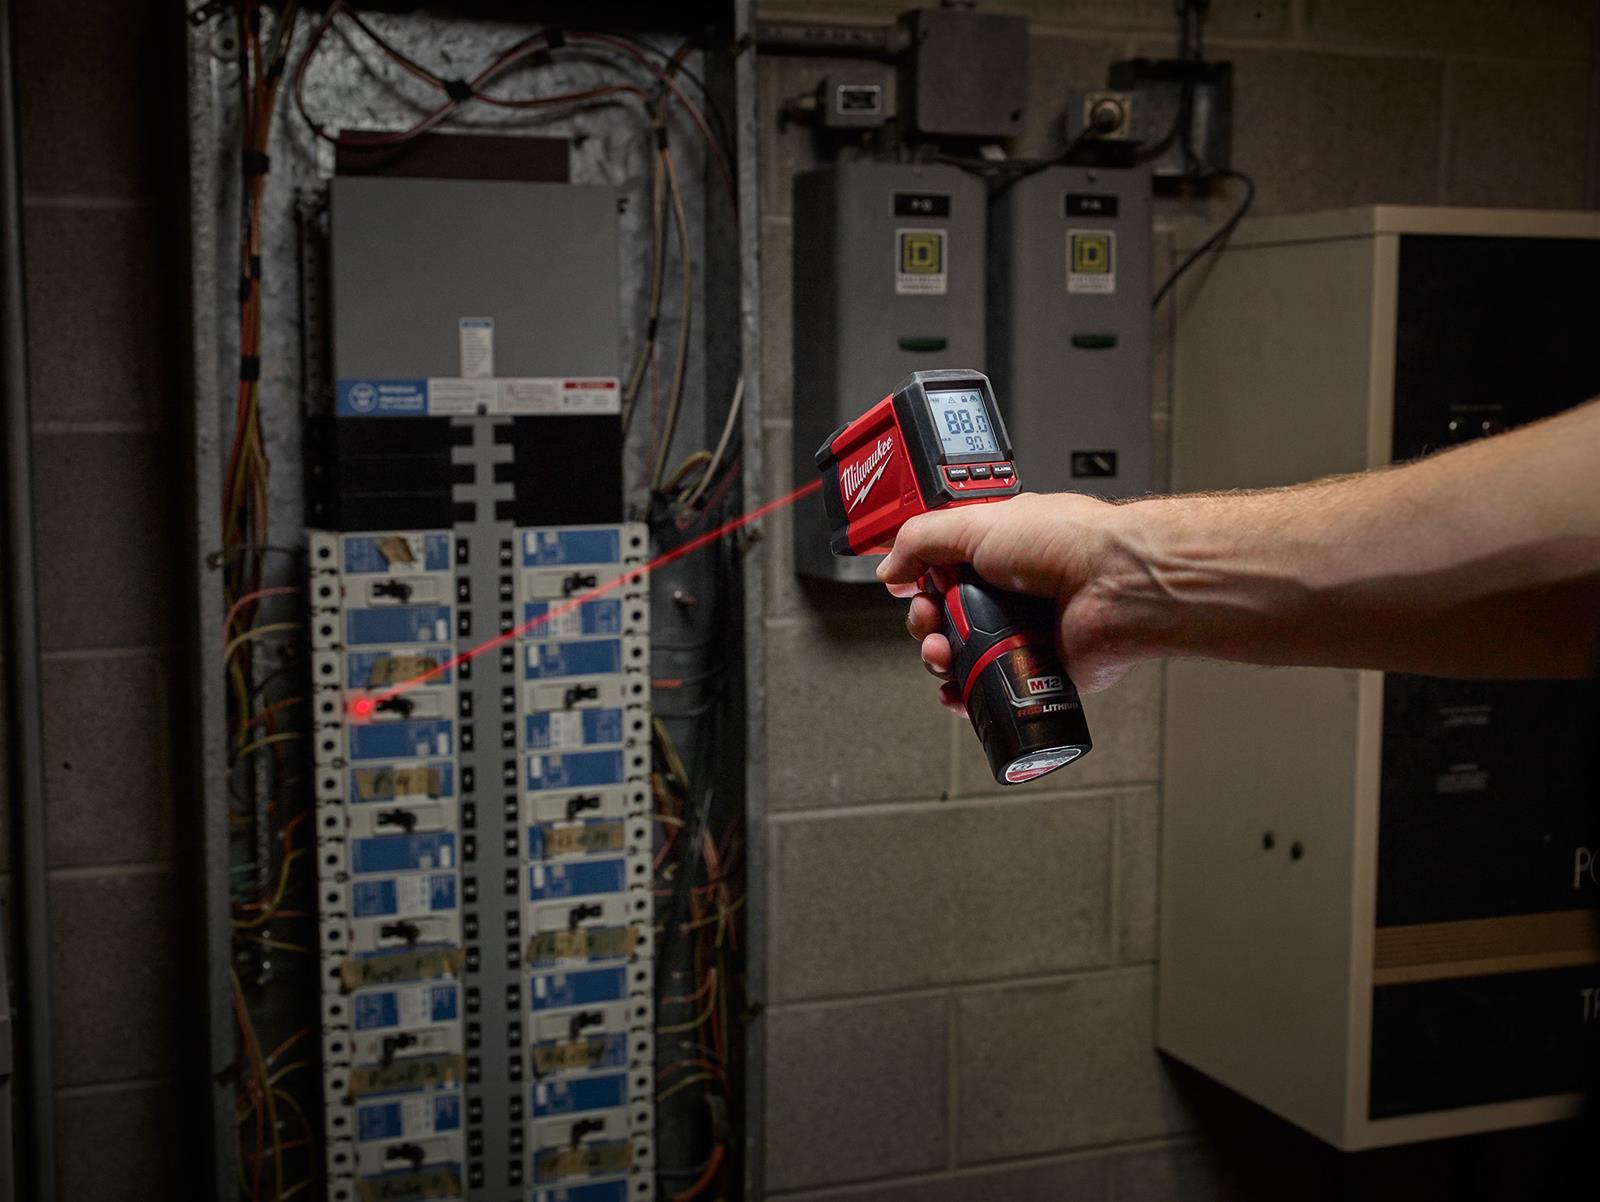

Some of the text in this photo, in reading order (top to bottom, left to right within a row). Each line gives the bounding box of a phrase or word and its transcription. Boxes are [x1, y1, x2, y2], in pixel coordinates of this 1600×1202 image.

[944, 409, 988, 434] 88.0
[840, 436, 892, 501] Milwaukee
[1030, 678, 1060, 691] M12
